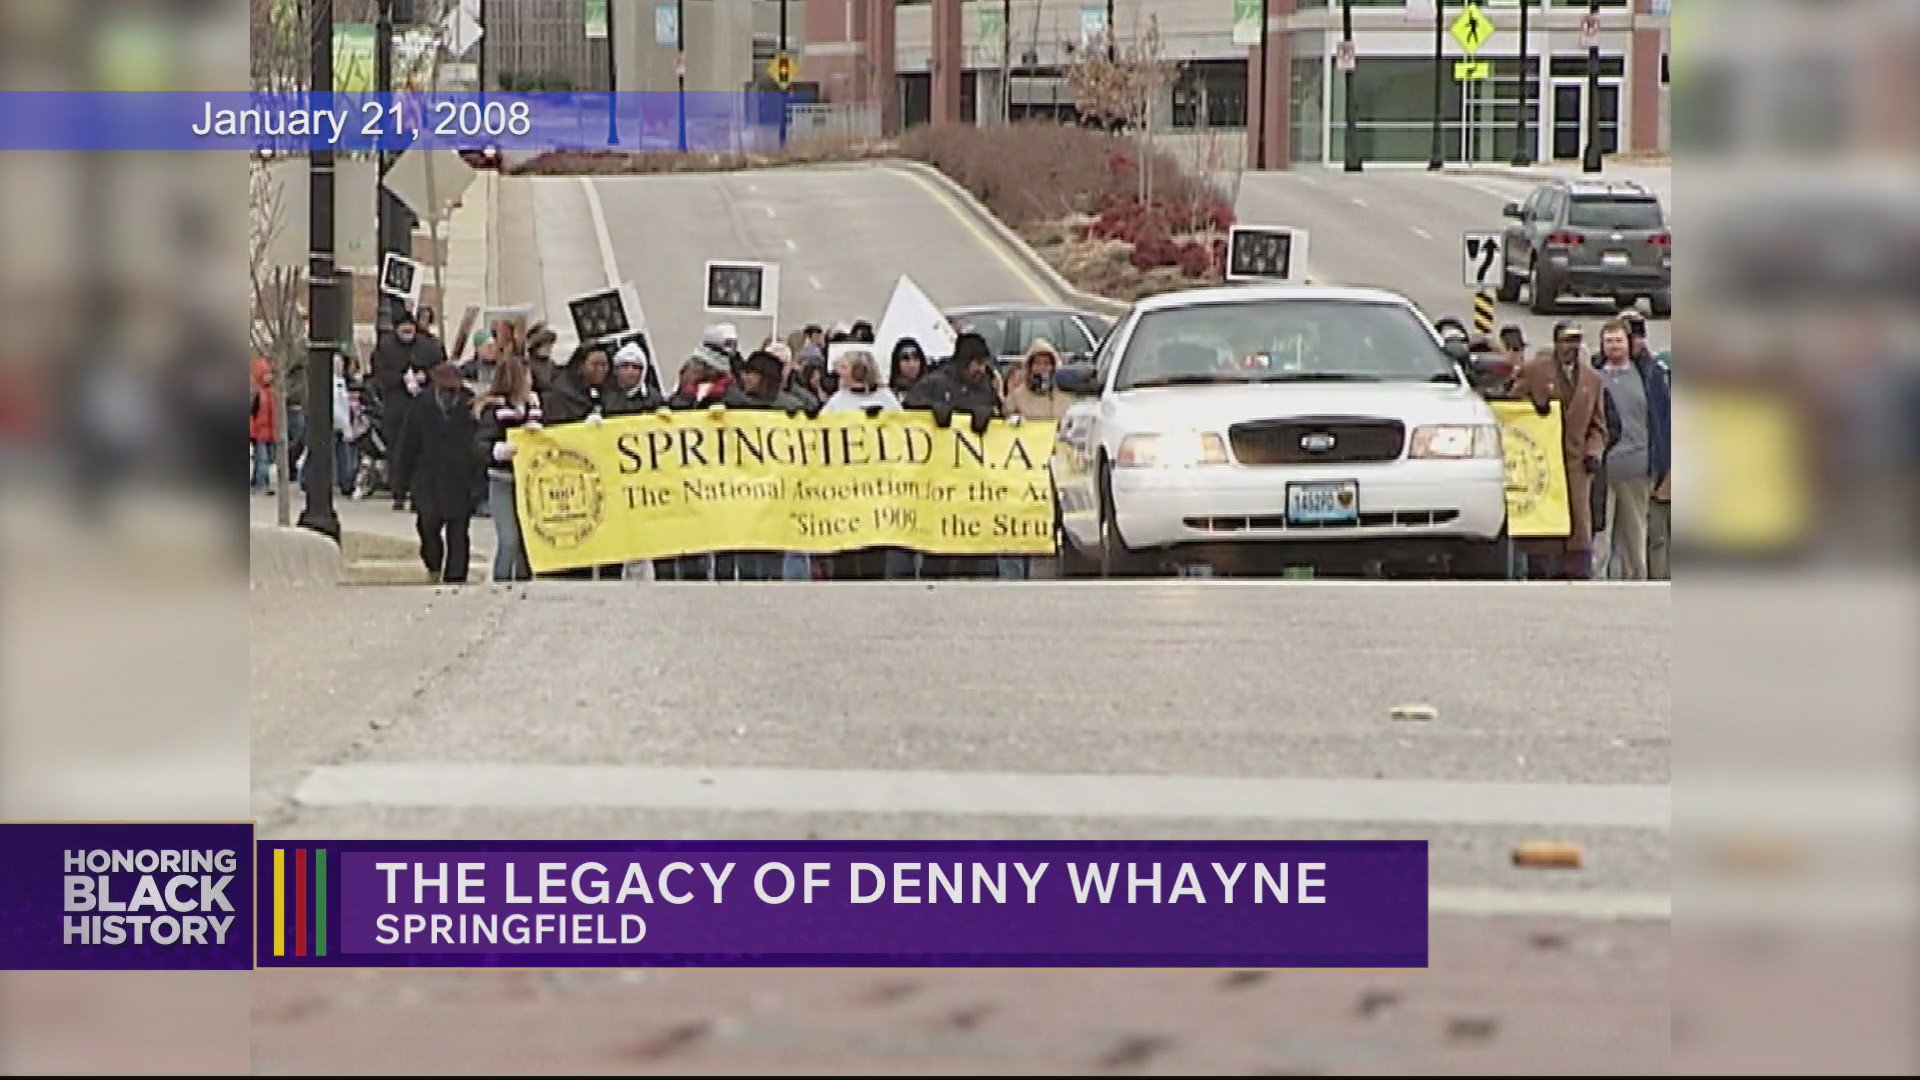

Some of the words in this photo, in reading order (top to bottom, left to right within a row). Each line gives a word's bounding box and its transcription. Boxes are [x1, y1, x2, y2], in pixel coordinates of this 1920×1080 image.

[616, 426, 933, 474] SPRINGFIELD
[622, 484, 671, 509] The
[682, 477, 786, 503] National
[793, 473, 919, 501] Association
[921, 478, 956, 502] for
[968, 480, 1008, 501] the
[941, 514, 981, 537] the
